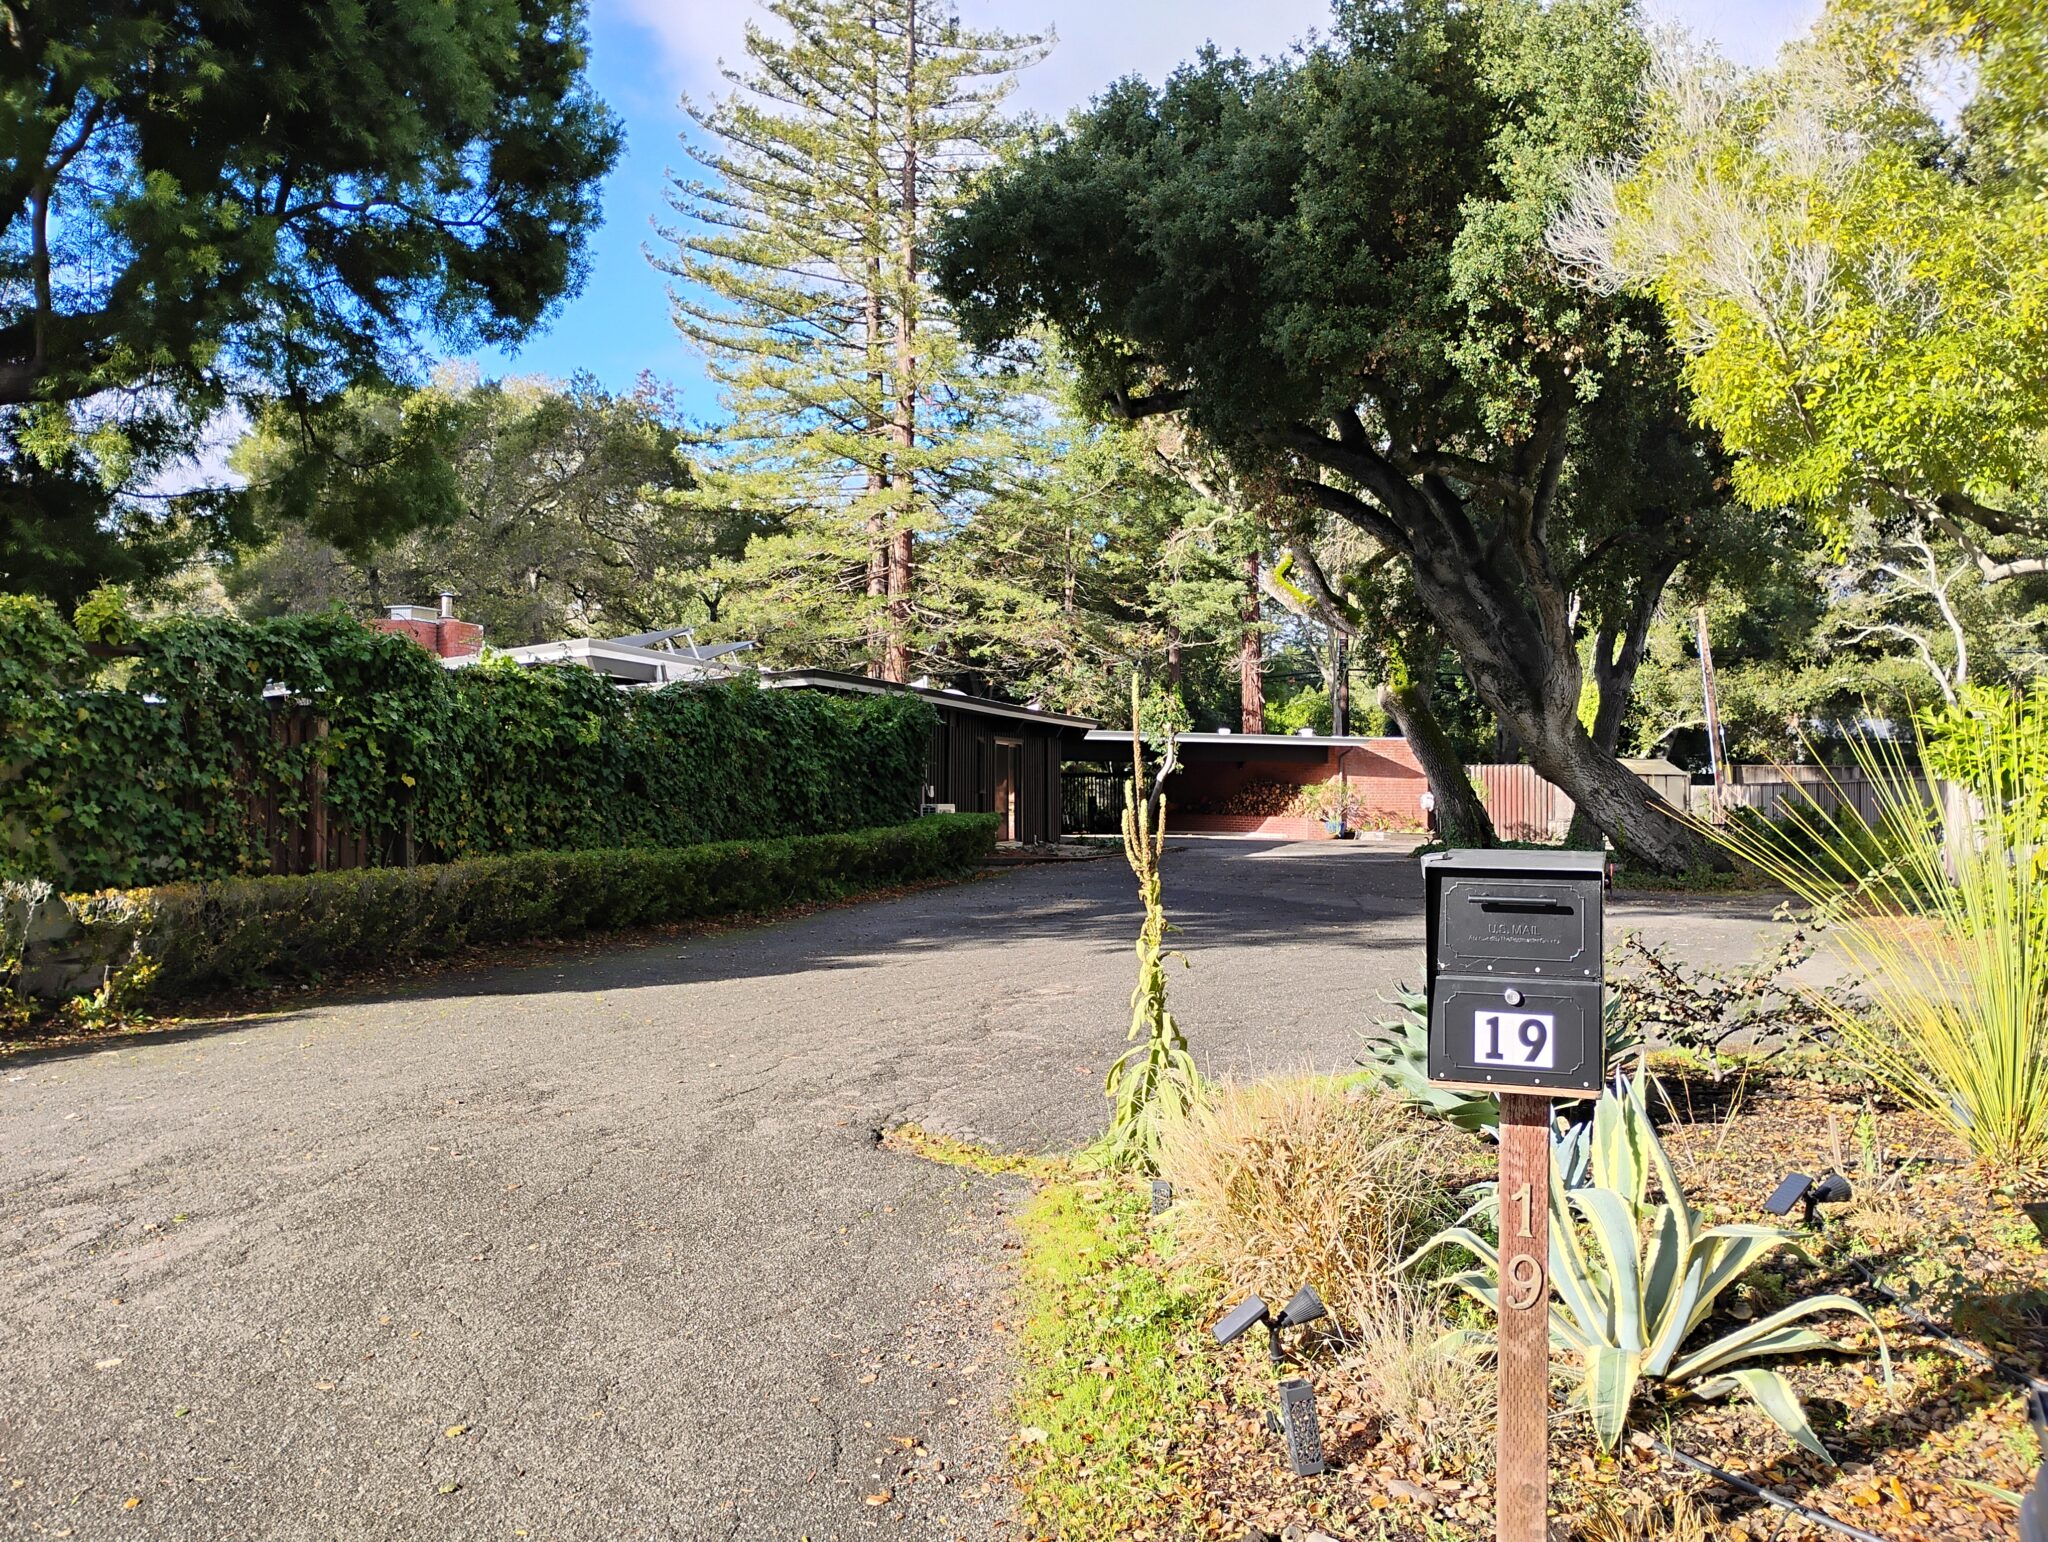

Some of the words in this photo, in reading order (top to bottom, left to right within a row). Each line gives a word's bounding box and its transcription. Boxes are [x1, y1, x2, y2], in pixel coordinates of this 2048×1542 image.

[1488, 923, 1510, 935] U.S.
[1512, 925, 1540, 936] MAIL
[1485, 1016, 1547, 1062] 19
